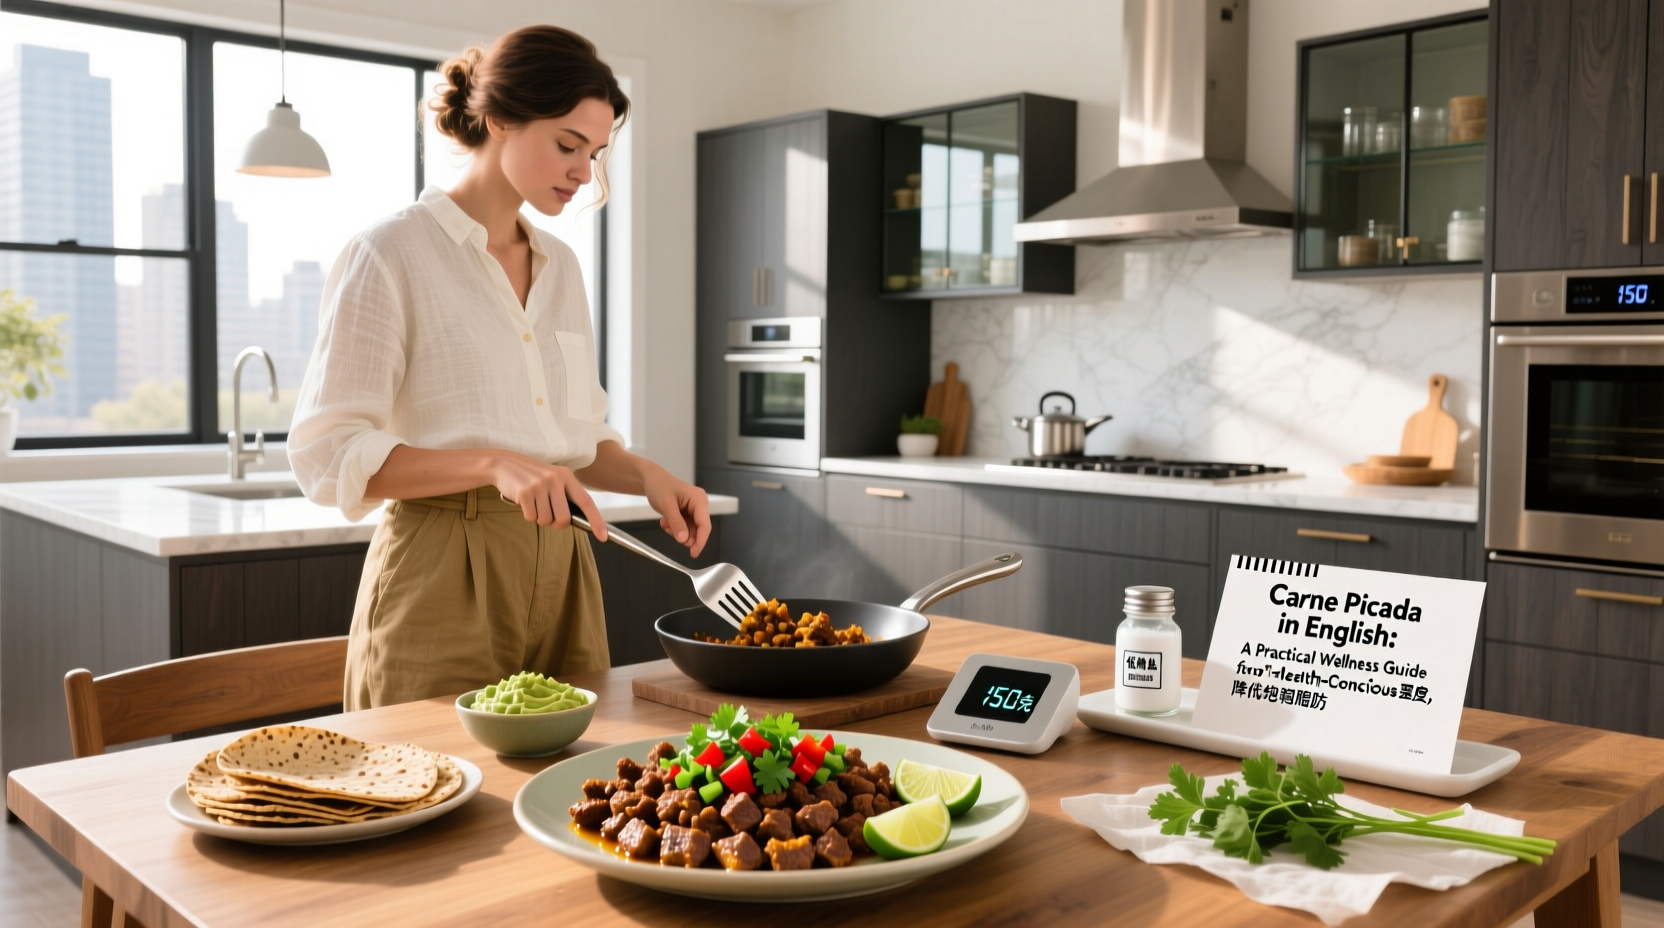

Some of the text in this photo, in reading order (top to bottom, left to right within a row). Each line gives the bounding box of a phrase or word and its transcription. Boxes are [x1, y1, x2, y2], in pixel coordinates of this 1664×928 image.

[1617, 284, 1649, 304] 150
[1269, 583, 1422, 622] Carne Picada
[1277, 612, 1398, 648] in English:
[1240, 641, 1428, 679] A Practical Wellness Guide
